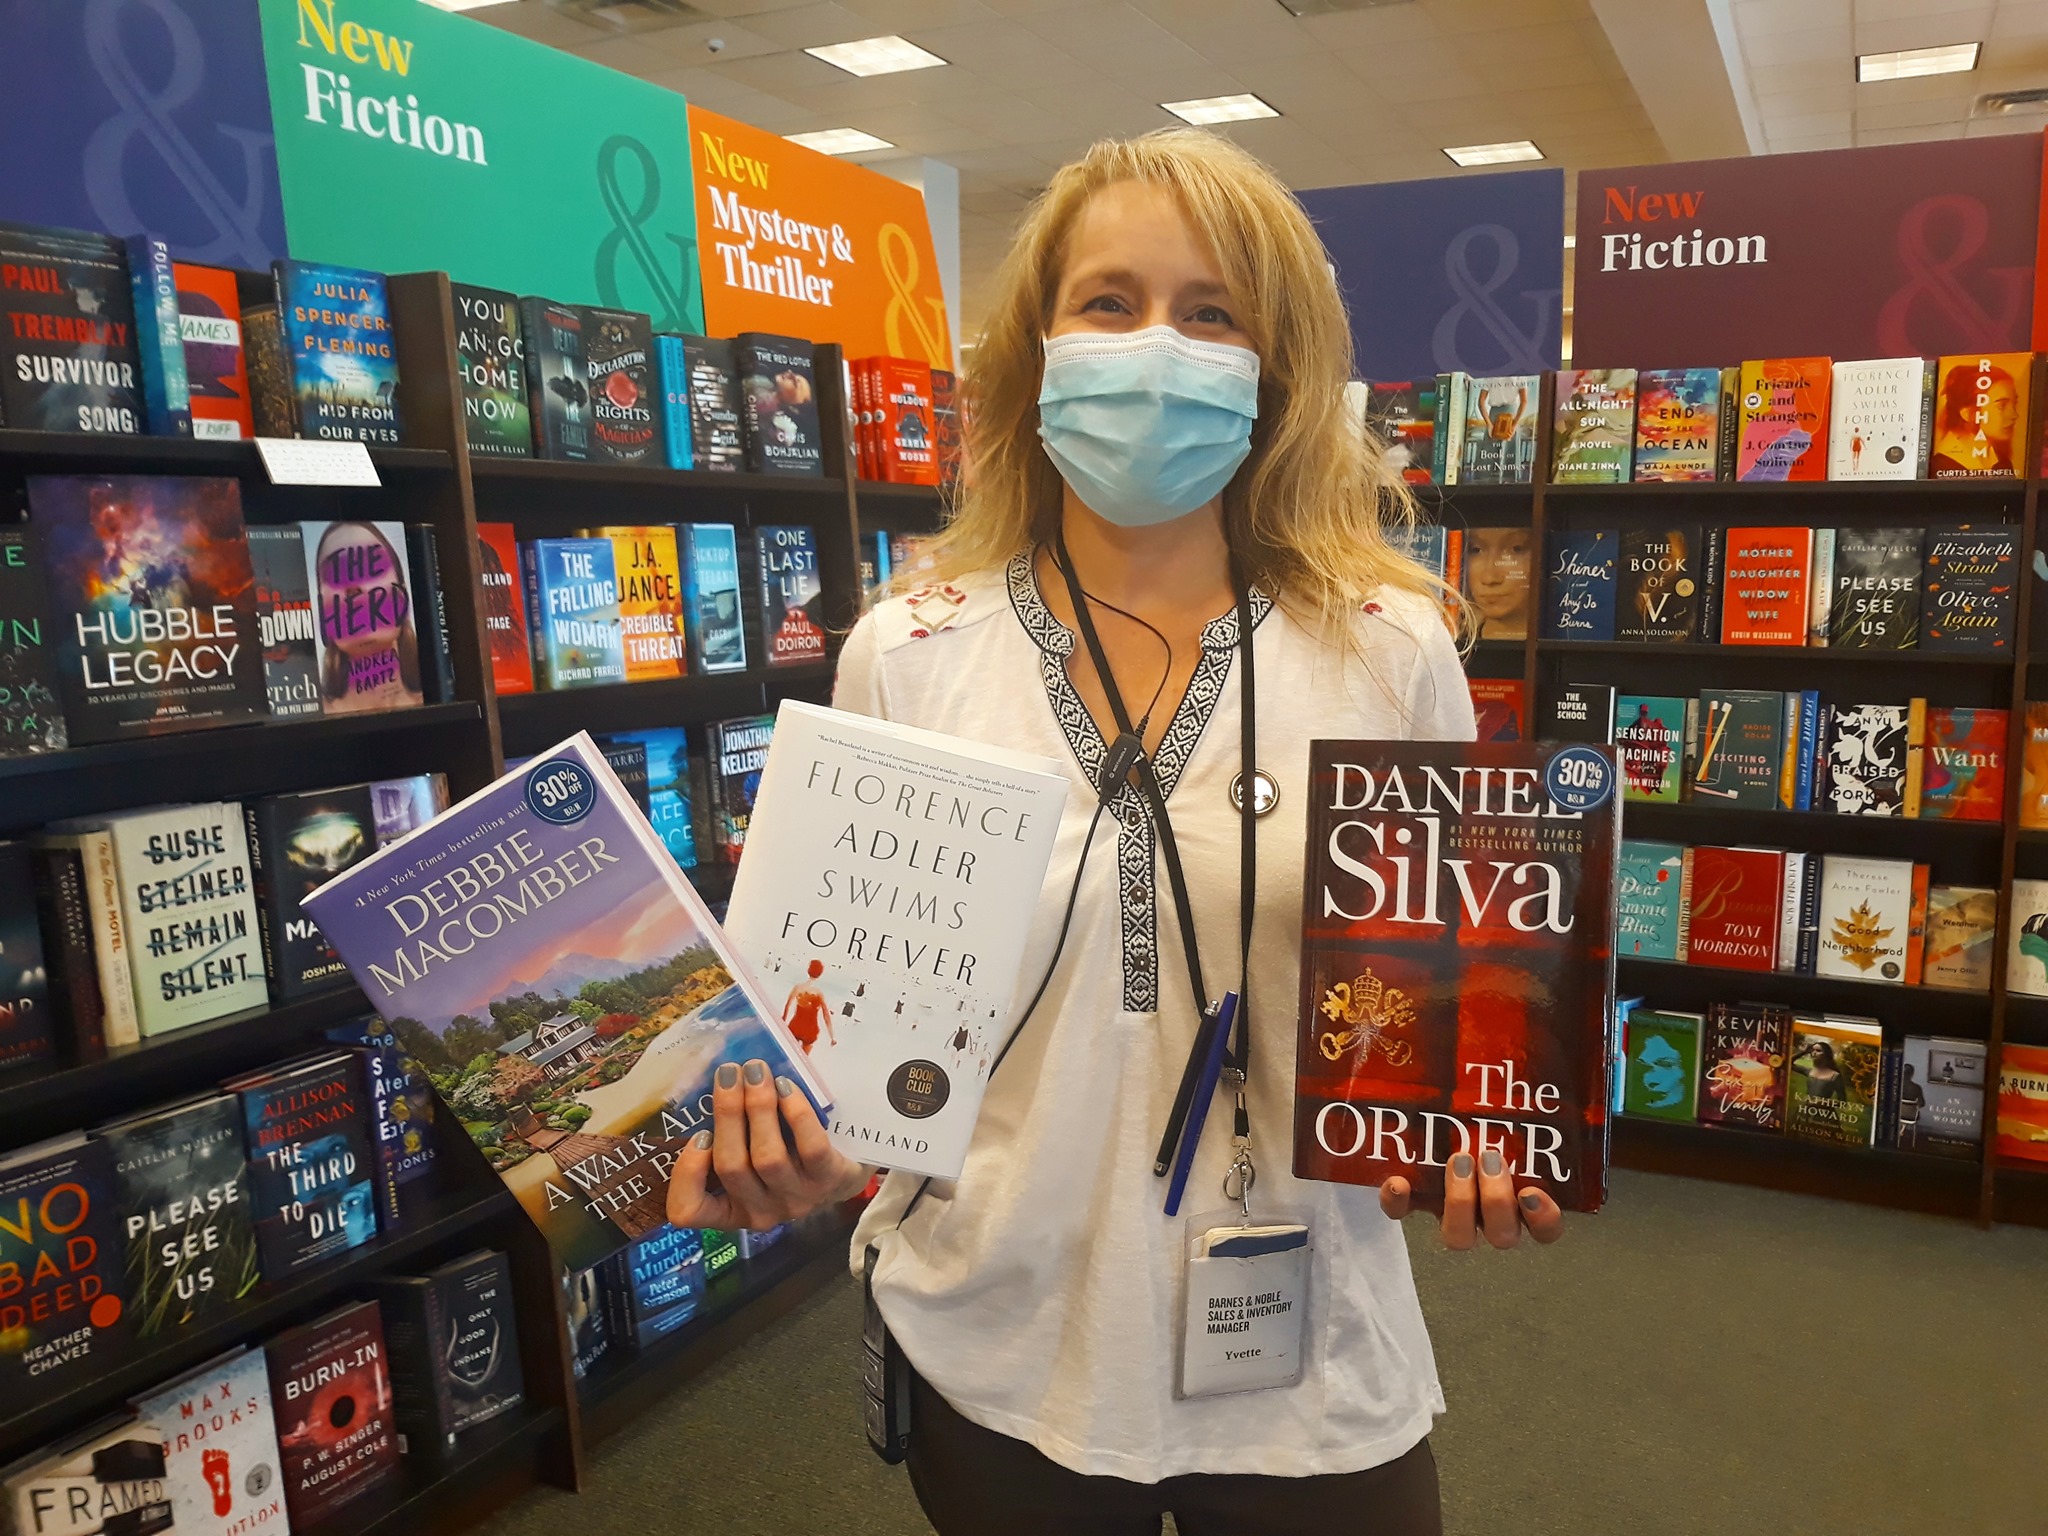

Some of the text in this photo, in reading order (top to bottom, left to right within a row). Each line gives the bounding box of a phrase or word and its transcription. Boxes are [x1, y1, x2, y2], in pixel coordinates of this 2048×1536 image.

[296, 0, 414, 77] New
[299, 62, 488, 166] Fiction
[700, 131, 769, 190] New
[1602, 185, 1704, 225] New
[1600, 229, 1768, 273] Fiction
[1, 264, 64, 297] PAUL
[716, 241, 835, 308] Thriller
[153, 240, 178, 347] FOLLOW ME
[313, 282, 371, 302] JULIA
[459, 295, 505, 323] YOU
[7, 311, 129, 349] TREMBLAY
[303, 335, 392, 360] FLEMING
[16, 353, 134, 390] SURVIVOR
[1755, 375, 1811, 391] Friends
[1583, 381, 1608, 395] THE
[465, 397, 517, 421] NOW
[1559, 398, 1630, 412] ALL-NIGHT
[1768, 393, 1795, 407] and
[78, 404, 134, 434] SONG
[318, 404, 395, 422] HID FROM
[595, 405, 651, 422] RIGHTS
[1580, 414, 1606, 428] SUN
[1658, 406, 1696, 421] END
[1745, 408, 1818, 425] Strangers
[1844, 412, 1905, 425] FOREVER
[319, 424, 399, 444] OUR EYES
[1643, 437, 1709, 452] OCEAN
[1558, 461, 1622, 472] DIANE ZINNA
[1754, 455, 1805, 469] Sullivan
[776, 529, 807, 548] ONE
[1645, 543, 1672, 556] THE
[1931, 541, 2014, 558] Elizabeth
[327, 543, 383, 584] THE
[630, 541, 662, 570] J.A.
[769, 550, 814, 572] LAST
[1630, 556, 1687, 574] BOOK
[1738, 548, 1794, 559] MOTHER
[561, 552, 595, 579] THE
[1729, 568, 1801, 580] DAUGHTER
[1944, 561, 1999, 577] Strout
[618, 574, 676, 604] JANCE
[780, 575, 809, 599] LIE
[1738, 589, 1790, 600] WIDOW
[1840, 577, 1914, 592] PLEASE
[550, 580, 615, 616] FALLING
[1855, 599, 1895, 616] SEE
[1937, 590, 2000, 612] Olive,
[315, 582, 410, 645] HERD
[620, 614, 675, 636] CREDIBLE
[1746, 610, 1779, 620] WIFE
[1935, 613, 1999, 631] Again
[75, 605, 238, 647] HUBBLE
[556, 618, 619, 651] WOMAN
[782, 620, 814, 637] PAUL
[1620, 628, 1689, 638] ANNA SOLOMON
[1860, 621, 1887, 637] US
[628, 637, 683, 663] THREAT
[776, 634, 822, 652] DOIRON
[81, 644, 241, 690] LEGACY
[348, 648, 400, 677] ANDREA
[354, 669, 397, 694] BARTZ
[1557, 701, 1588, 711] TOPEKA
[1565, 692, 1581, 702] THE
[1557, 711, 1587, 721] SCHOOL
[1615, 727, 1681, 743] SENSATION
[1615, 747, 1676, 763] MACHINES
[1713, 753, 1768, 764] EXCITING
[1931, 746, 1999, 769] Want
[1557, 758, 1604, 790] 30%
[1737, 765, 1772, 776] TIMES
[1831, 764, 1900, 779] BRAISED
[535, 767, 579, 808] 30%
[1832, 788, 1877, 801] PORK
[807, 760, 1032, 842] FLORENCE
[1450, 825, 1583, 841] #1 NEW YORK TIMES
[147, 825, 226, 866] SUSIE
[366, 885, 392, 902] New
[390, 870, 418, 887] York
[415, 852, 448, 873] Times
[450, 817, 507, 854] bestselling
[507, 800, 530, 819] auth
[833, 821, 977, 885] ADLER
[1449, 837, 1584, 854] BESTSELLING AUTHOR
[386, 828, 546, 940] DEBBIE
[1324, 816, 1575, 934] Silva
[1846, 869, 1889, 881] Therese
[137, 866, 247, 914] STEINER
[817, 869, 968, 931] SWIMS
[367, 835, 621, 997] MACOMBER
[150, 911, 248, 958] REMAIN
[1723, 923, 1762, 938] TONI
[782, 912, 978, 987] FOREVER
[1689, 937, 1772, 959] MORRISON
[1821, 941, 1903, 959] Neighborhood
[160, 953, 249, 1002] SILENT
[1716, 1015, 1779, 1035] KEVIN
[1717, 1035, 1776, 1054] KWAN
[908, 1066, 936, 1083] BOOK
[906, 1078, 933, 1095] CLUB
[1466, 1060, 1561, 1116] The
[263, 1079, 348, 1121] ALLISON
[1929, 1105, 1977, 1117] ELEGANT
[258, 1100, 356, 1147] BRENNAN
[1797, 1104, 1859, 1125] HOWARD
[1932, 1115, 1973, 1127] WOMAN
[1314, 1101, 1572, 1183] ORDER
[266, 1141, 304, 1172] THE
[288, 1151, 357, 1196] THIRD
[584, 1173, 652, 1222] THE
[126, 1179, 240, 1240] PLEASE
[280, 1200, 304, 1226] TO
[309, 1205, 349, 1240] DIE
[161, 1225, 220, 1268] SEE
[634, 1241, 700, 1283] Murders
[175, 1266, 215, 1301] US
[1207, 1300, 1293, 1322] SALES & INVENTORY
[1208, 1290, 1281, 1309] BARNES & NOBLE
[1206, 1321, 1250, 1335] MANAGER
[23, 1326, 93, 1364] HEATHER
[1225, 1347, 1262, 1361] Yvette
[28, 1342, 91, 1377] CHAVEZ
[285, 1342, 379, 1401] BURN-IN
[180, 1382, 232, 1421] MAX
[161, 1397, 258, 1459] BROOKS
[300, 1454, 352, 1490] AUGUST
[356, 1435, 388, 1460] COLE
[28, 1479, 163, 1534] FRAMED
